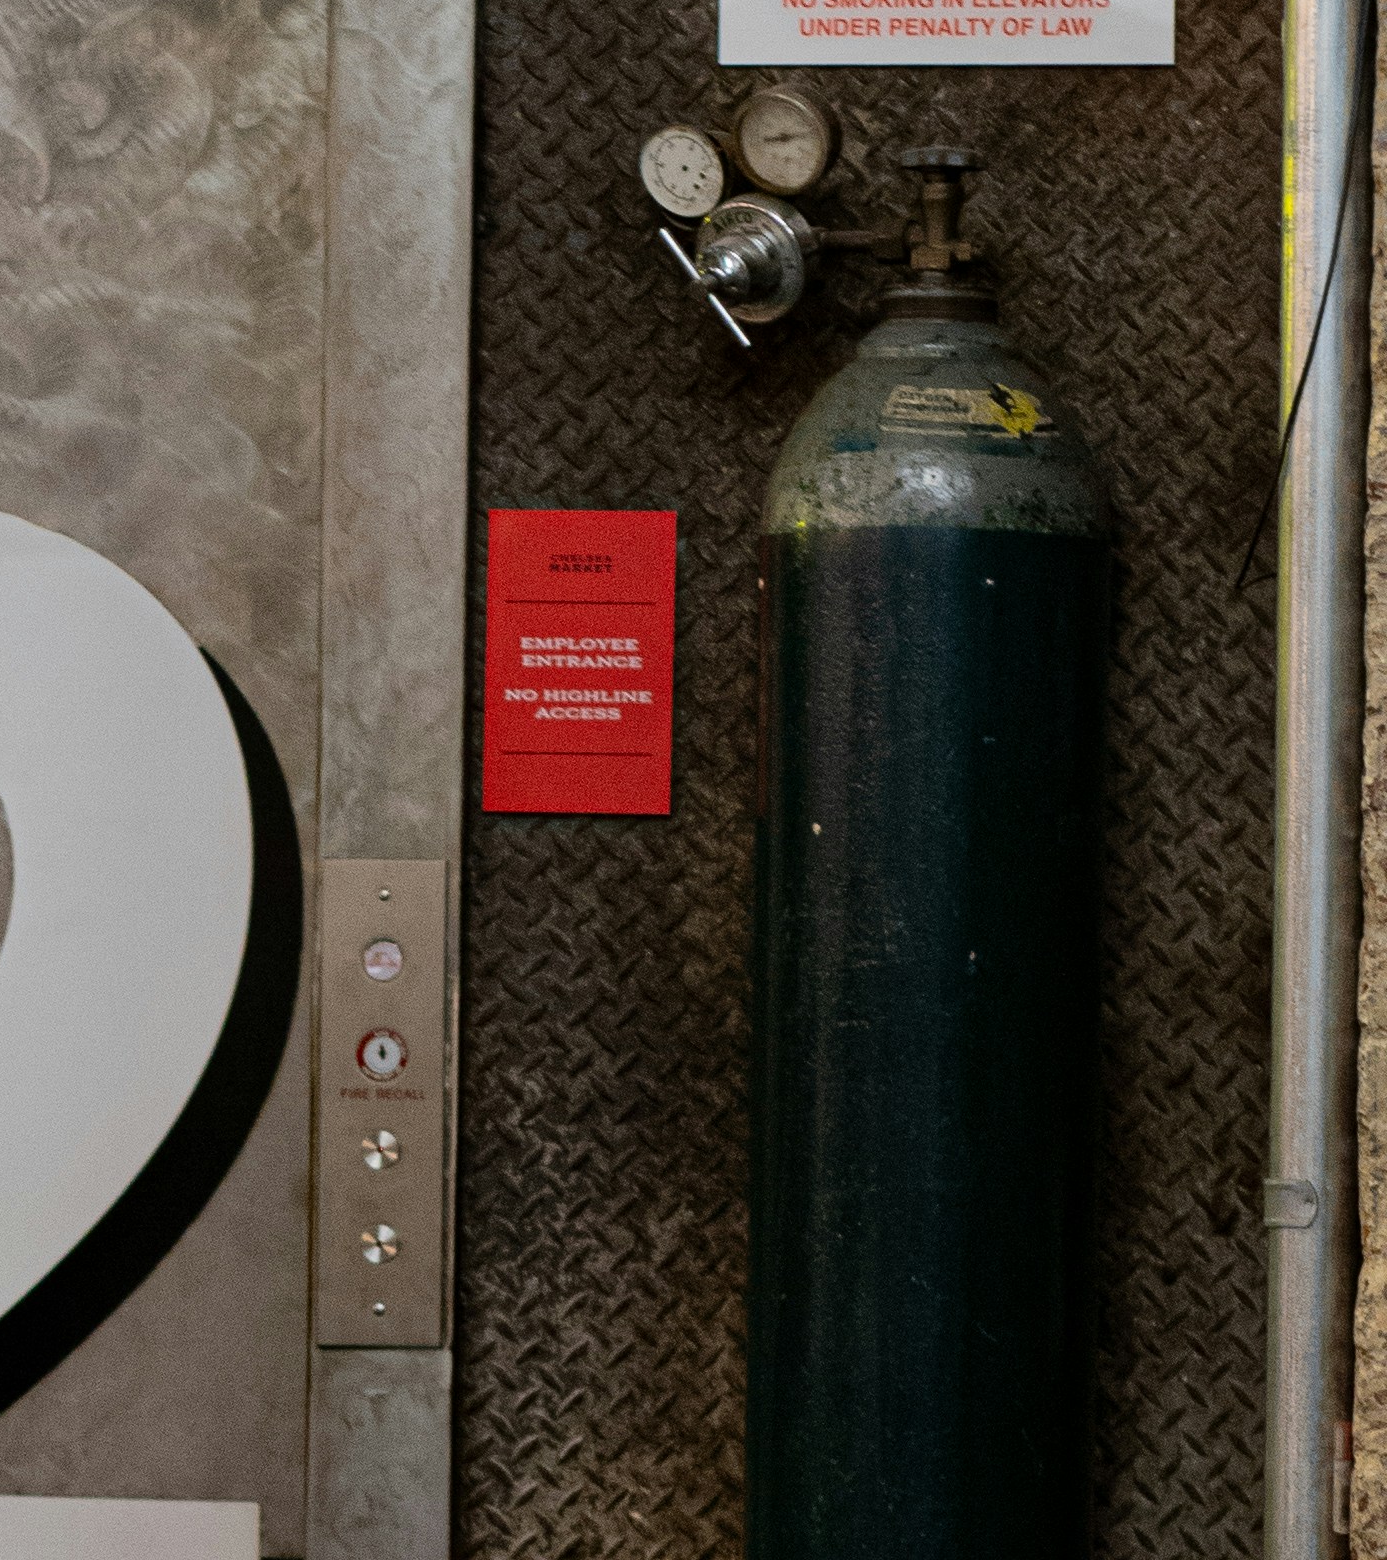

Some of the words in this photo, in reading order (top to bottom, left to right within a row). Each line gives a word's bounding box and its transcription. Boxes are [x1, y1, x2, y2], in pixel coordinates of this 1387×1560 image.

[800, 18, 881, 37] UNDER
[889, 17, 994, 37] PENALTY
[1001, 17, 1035, 37] OF
[1042, 17, 1094, 37] LAW
[550, 553, 613, 563] CHELSEA
[548, 562, 614, 574] MARKET
[519, 636, 640, 652] EMPLOYEE
[521, 654, 644, 670] ENTRANCE
[503, 688, 539, 702] NO
[543, 689, 653, 705] HIGHLINE
[534, 705, 622, 721] ACCESS
[340, 1087, 370, 1101] FIRE
[375, 1088, 427, 1101] RECALL
